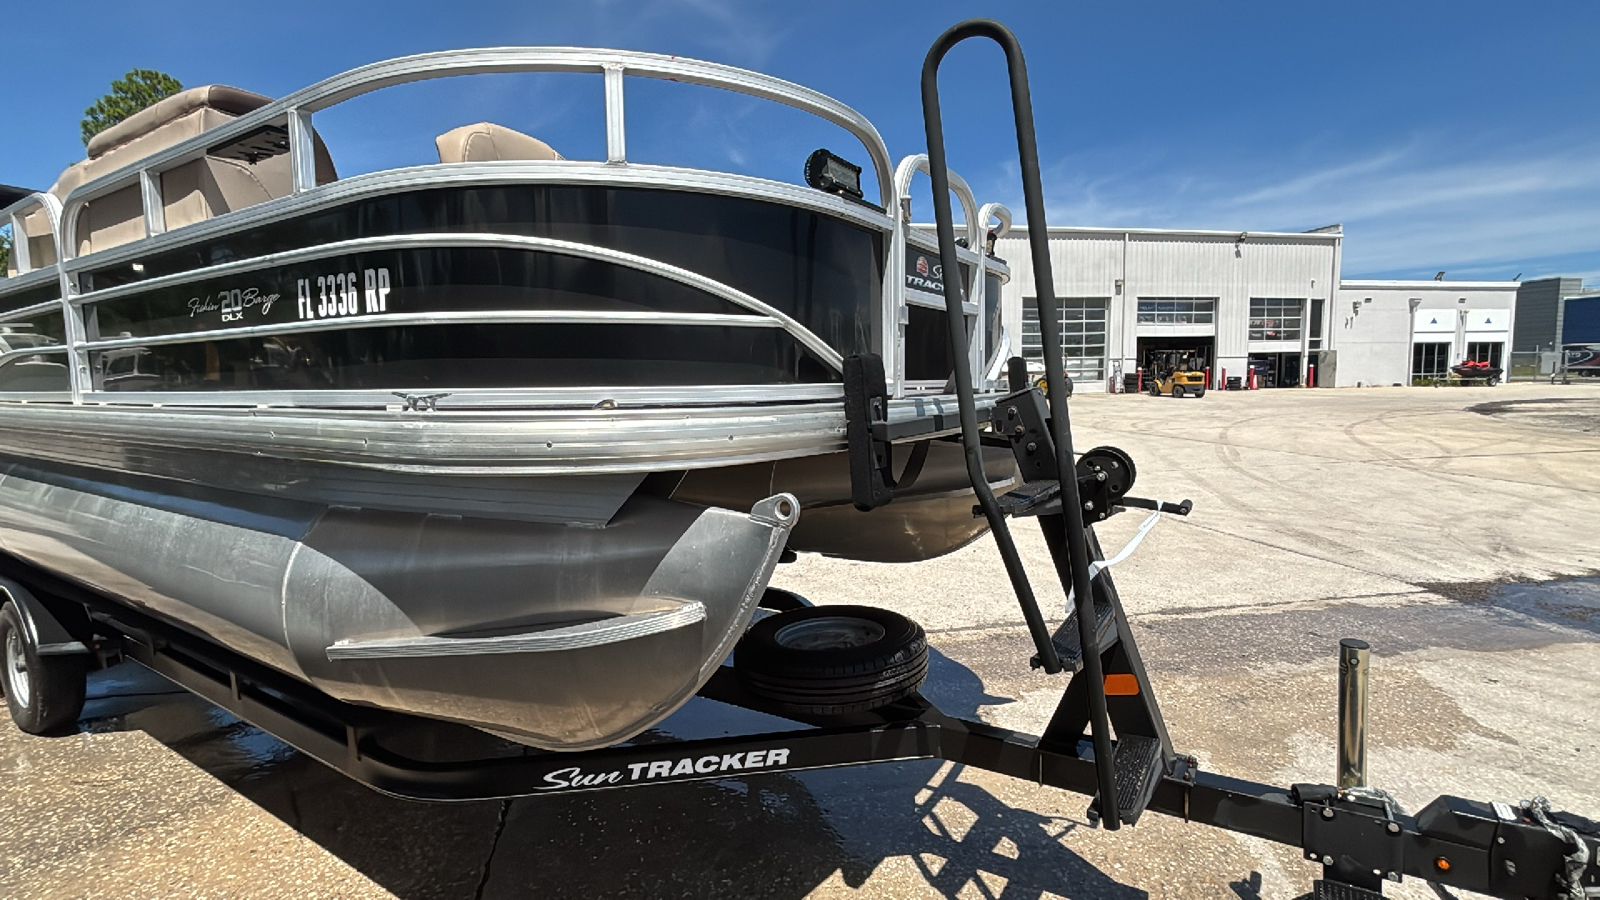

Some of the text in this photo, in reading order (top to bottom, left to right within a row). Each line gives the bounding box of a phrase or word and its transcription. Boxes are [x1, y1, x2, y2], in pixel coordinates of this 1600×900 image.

[220, 289, 243, 313] 20
[242, 288, 281, 315] Barge
[297, 268, 391, 319] FL 3336 RP
[221, 312, 244, 322] DLX
[533, 748, 790, 790] Sun TRACKER
